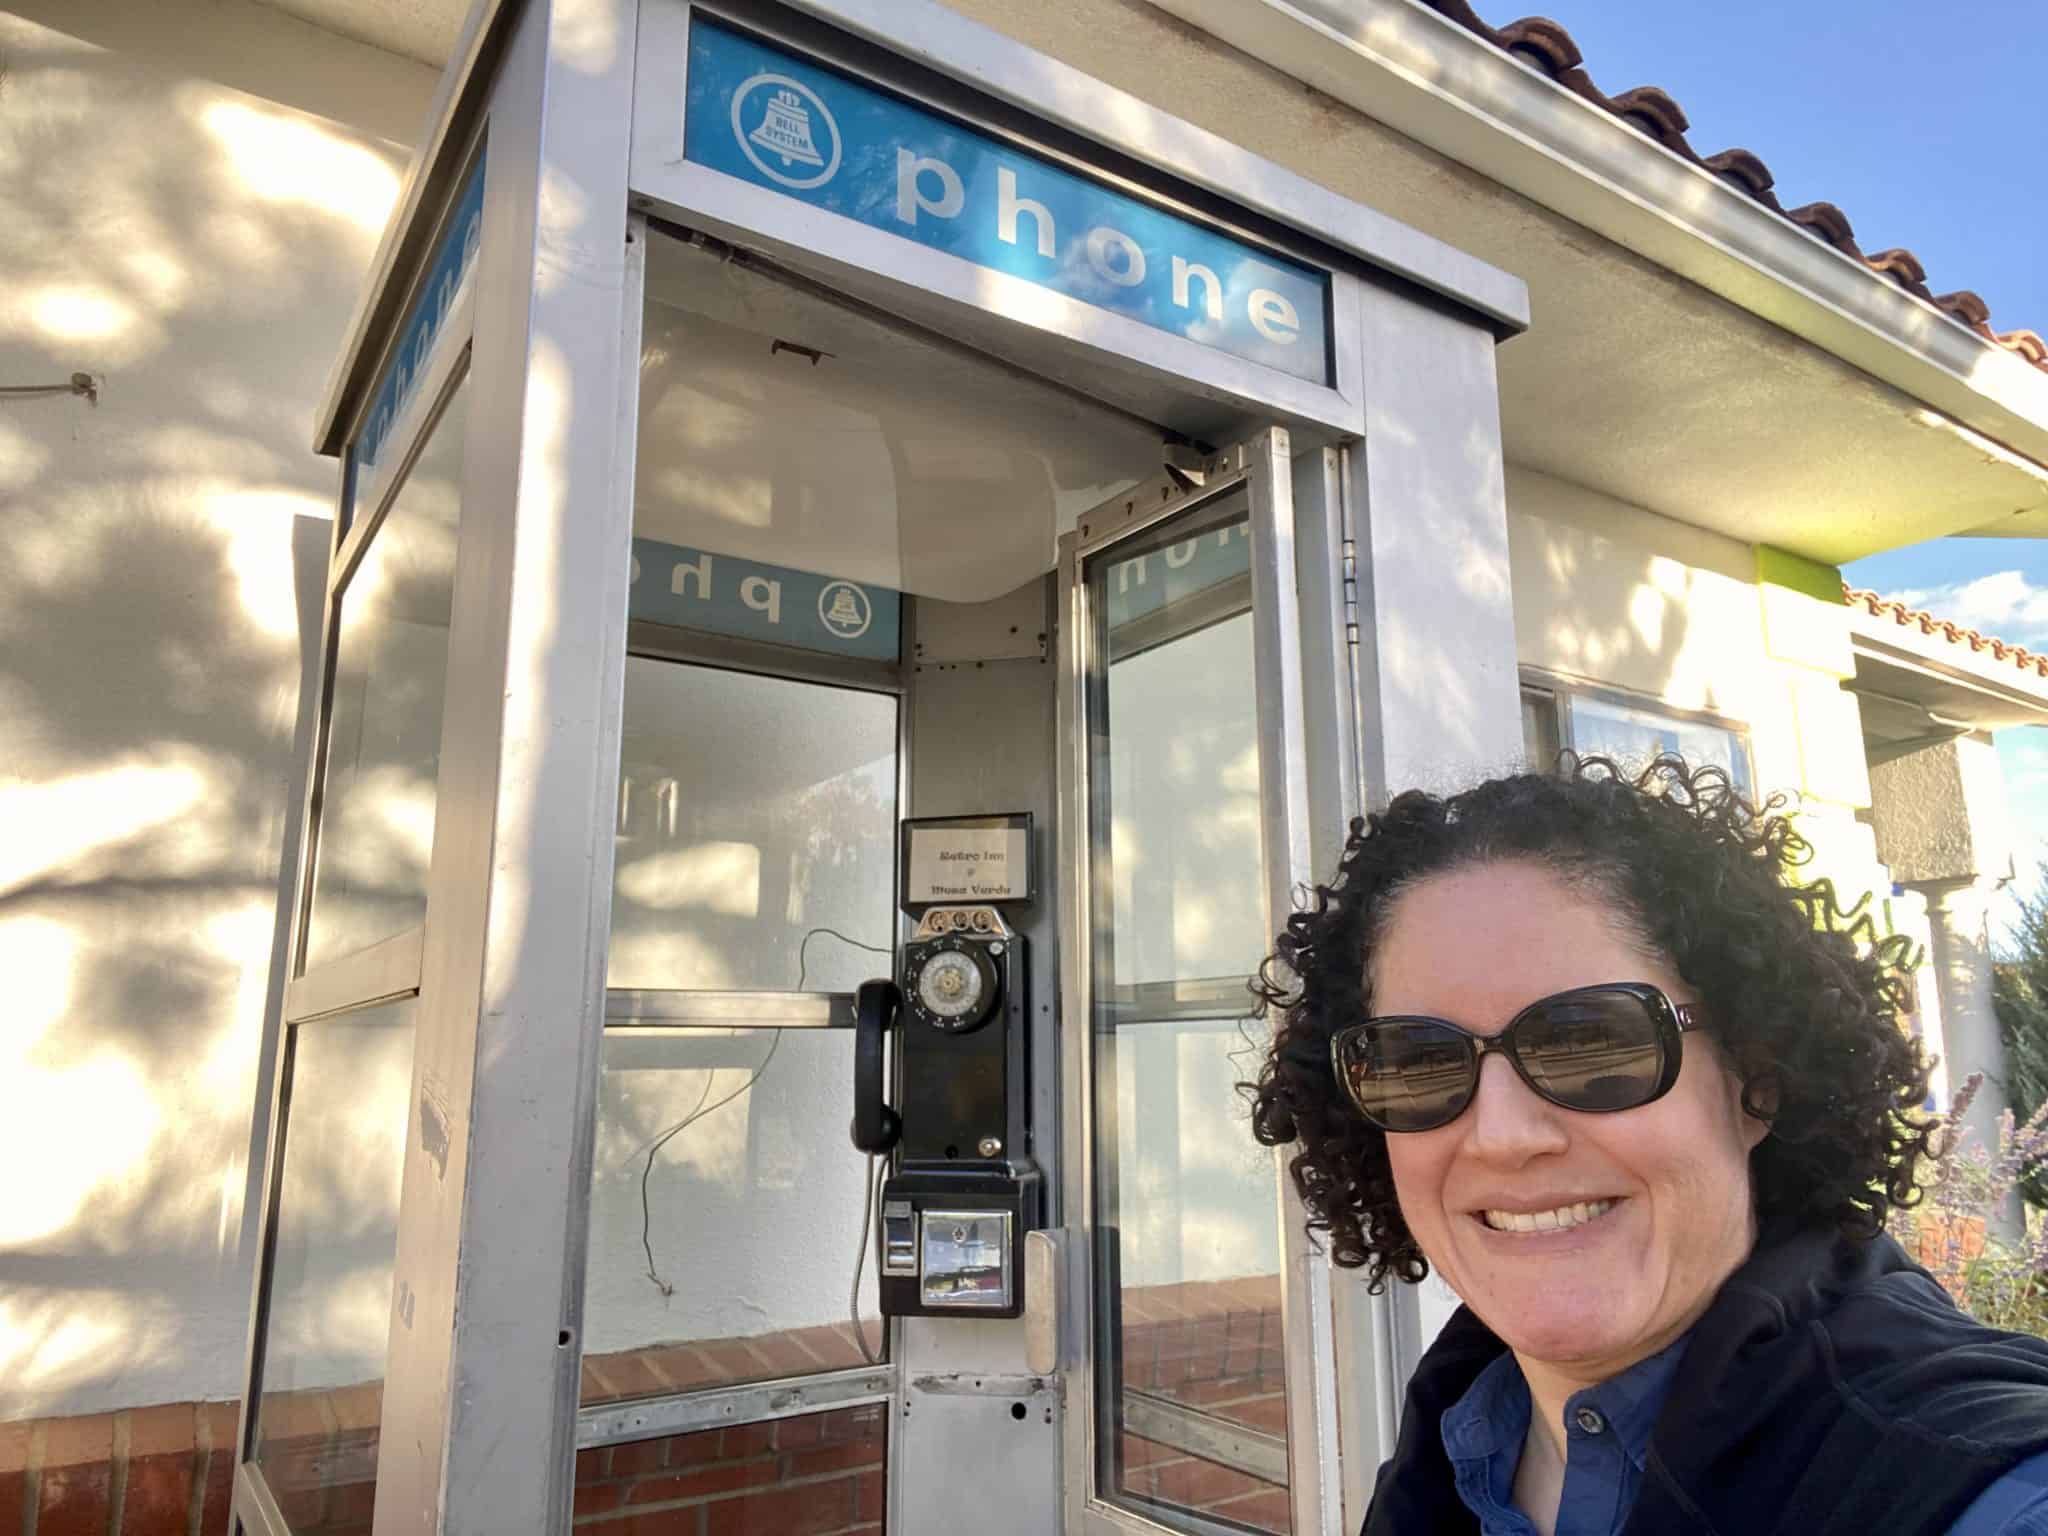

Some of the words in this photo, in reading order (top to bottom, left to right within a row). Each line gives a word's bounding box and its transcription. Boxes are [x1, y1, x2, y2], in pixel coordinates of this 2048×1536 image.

[776, 117, 799, 134] BELL
[766, 126, 808, 147] SYSTEM
[895, 147, 1299, 345] phone
